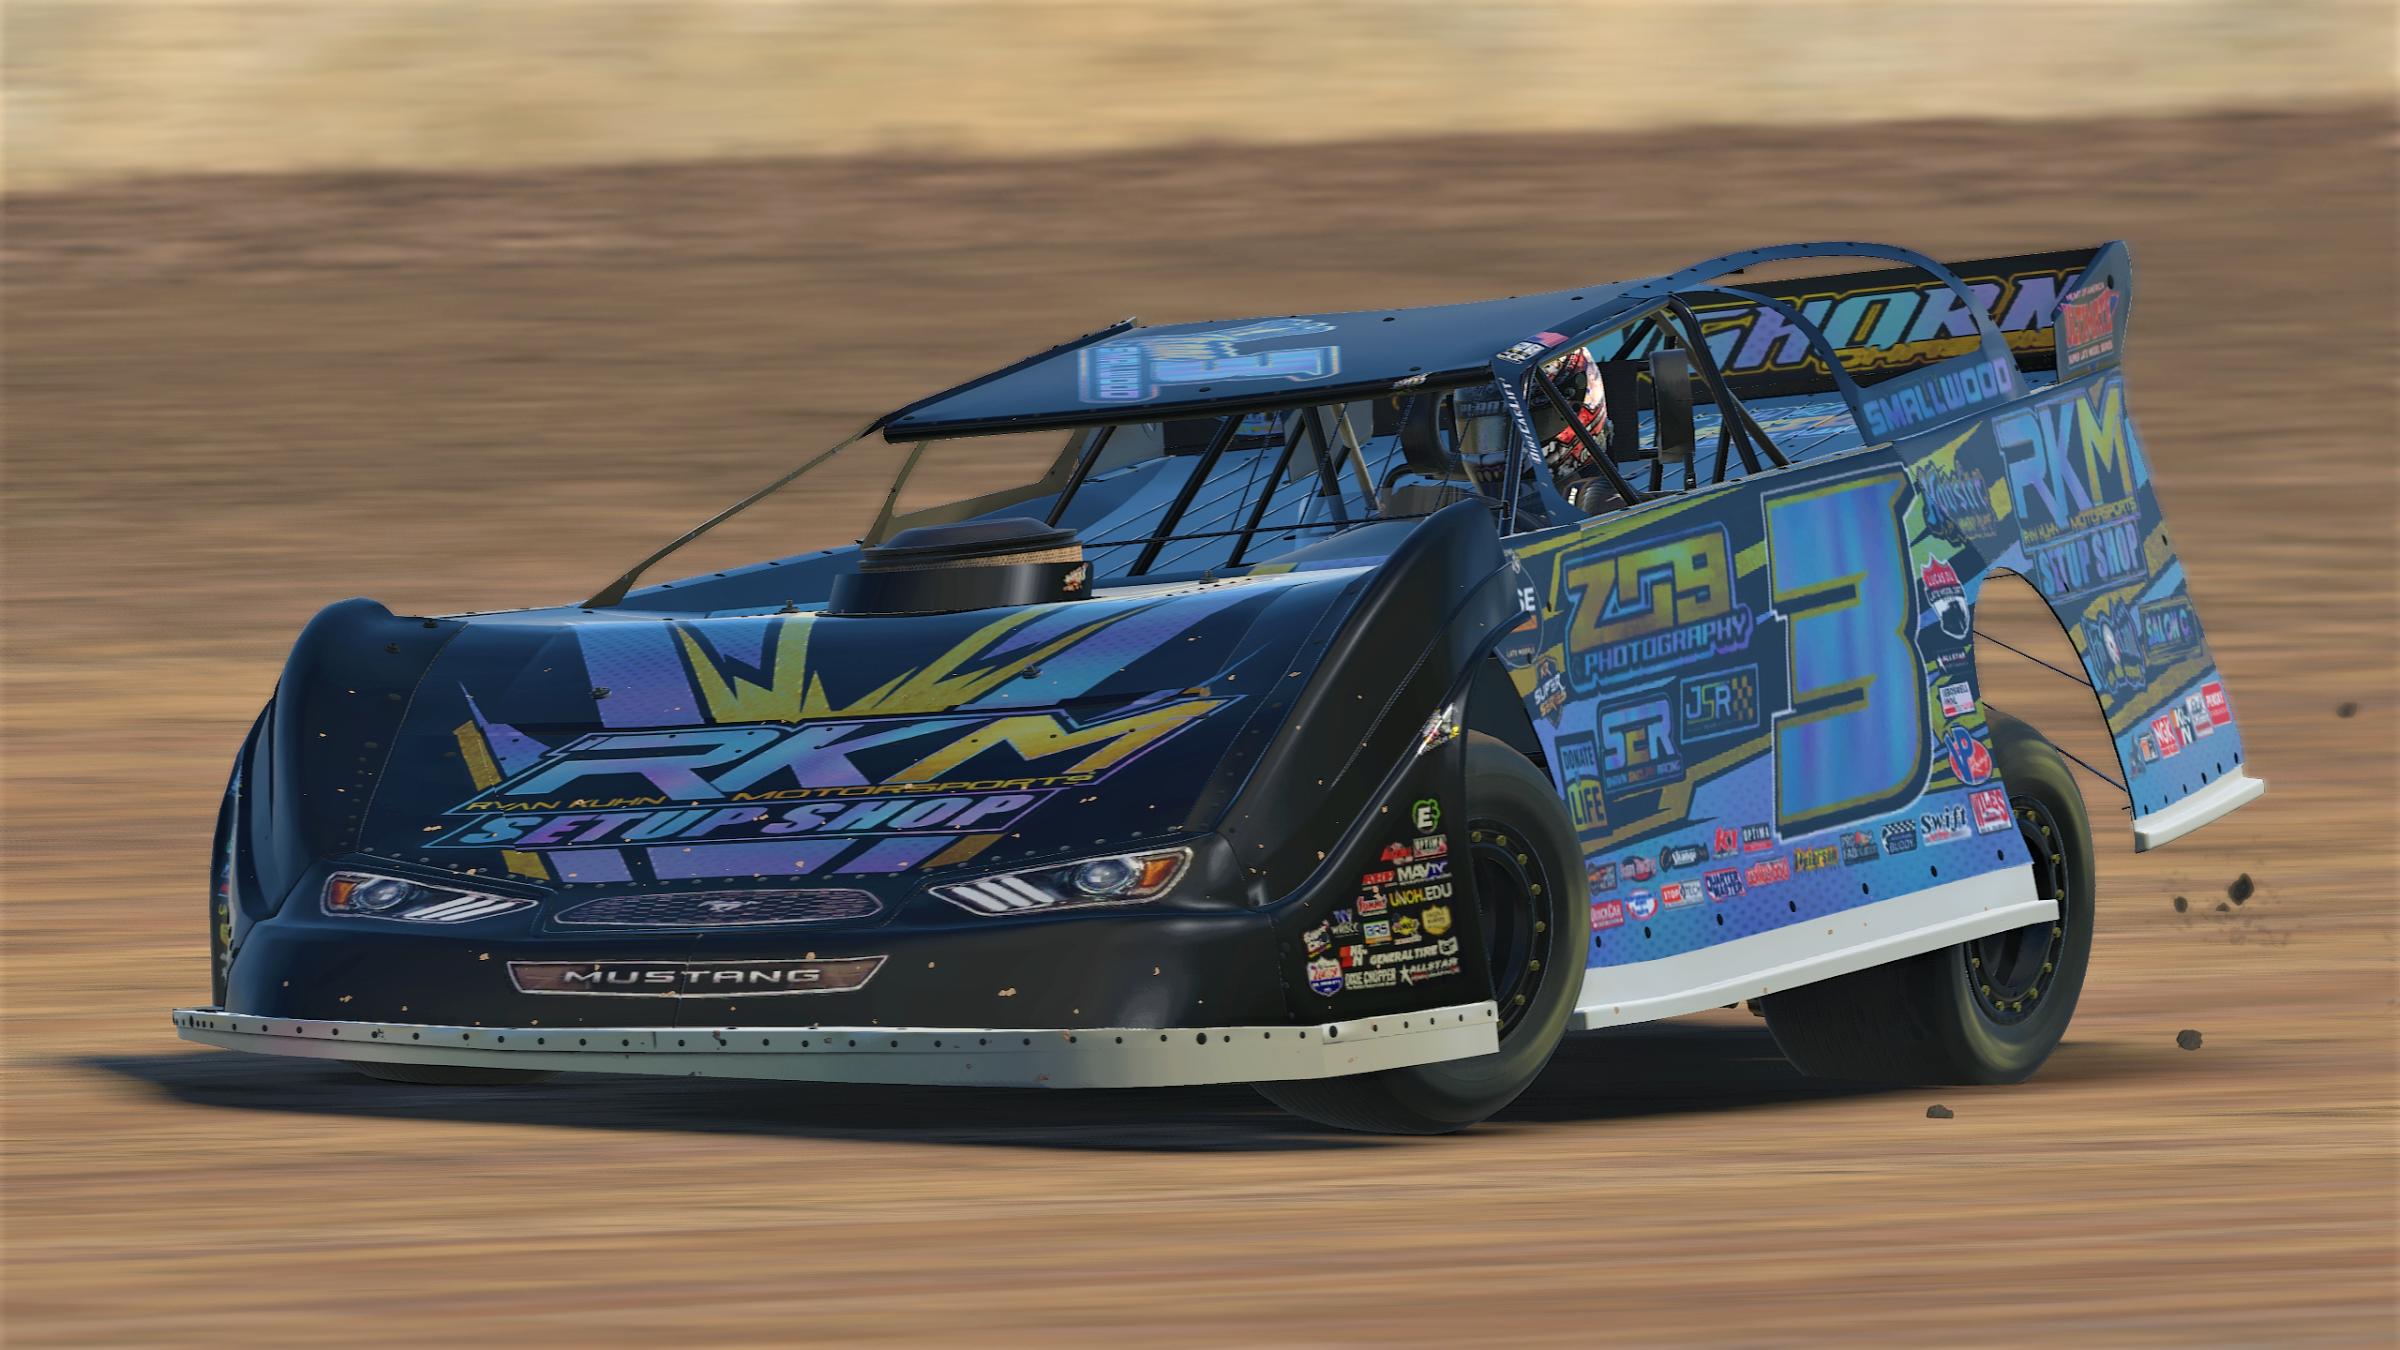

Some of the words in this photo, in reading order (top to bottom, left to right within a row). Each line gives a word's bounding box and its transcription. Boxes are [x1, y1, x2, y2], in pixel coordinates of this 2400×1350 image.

[1861, 357, 2013, 436] SMALLWOOD
[1994, 384, 2133, 528] RKM
[2092, 522, 2139, 579] SHOP
[1584, 613, 1746, 677] PHOTOGRAPHY
[1764, 468, 1927, 830] 3
[1534, 672, 1566, 705] SUPER
[506, 699, 1226, 800] RKM
[1562, 742, 1595, 770] DONATE
[467, 801, 561, 812] RYAN
[568, 796, 667, 808] KUHN
[731, 771, 1097, 800] MOTORSPORTS
[1569, 785, 1607, 827] LIFE
[460, 806, 768, 845] SETUP
[761, 793, 1040, 834] SHOP
[1743, 825, 1770, 842] OPTIMA
[1921, 806, 1967, 835] Swift
[1389, 883, 1453, 908] UNOH.EDU
[1369, 949, 1414, 965] GENERAL
[1415, 945, 1438, 959] TIRE
[563, 967, 821, 987] MUSTANG
